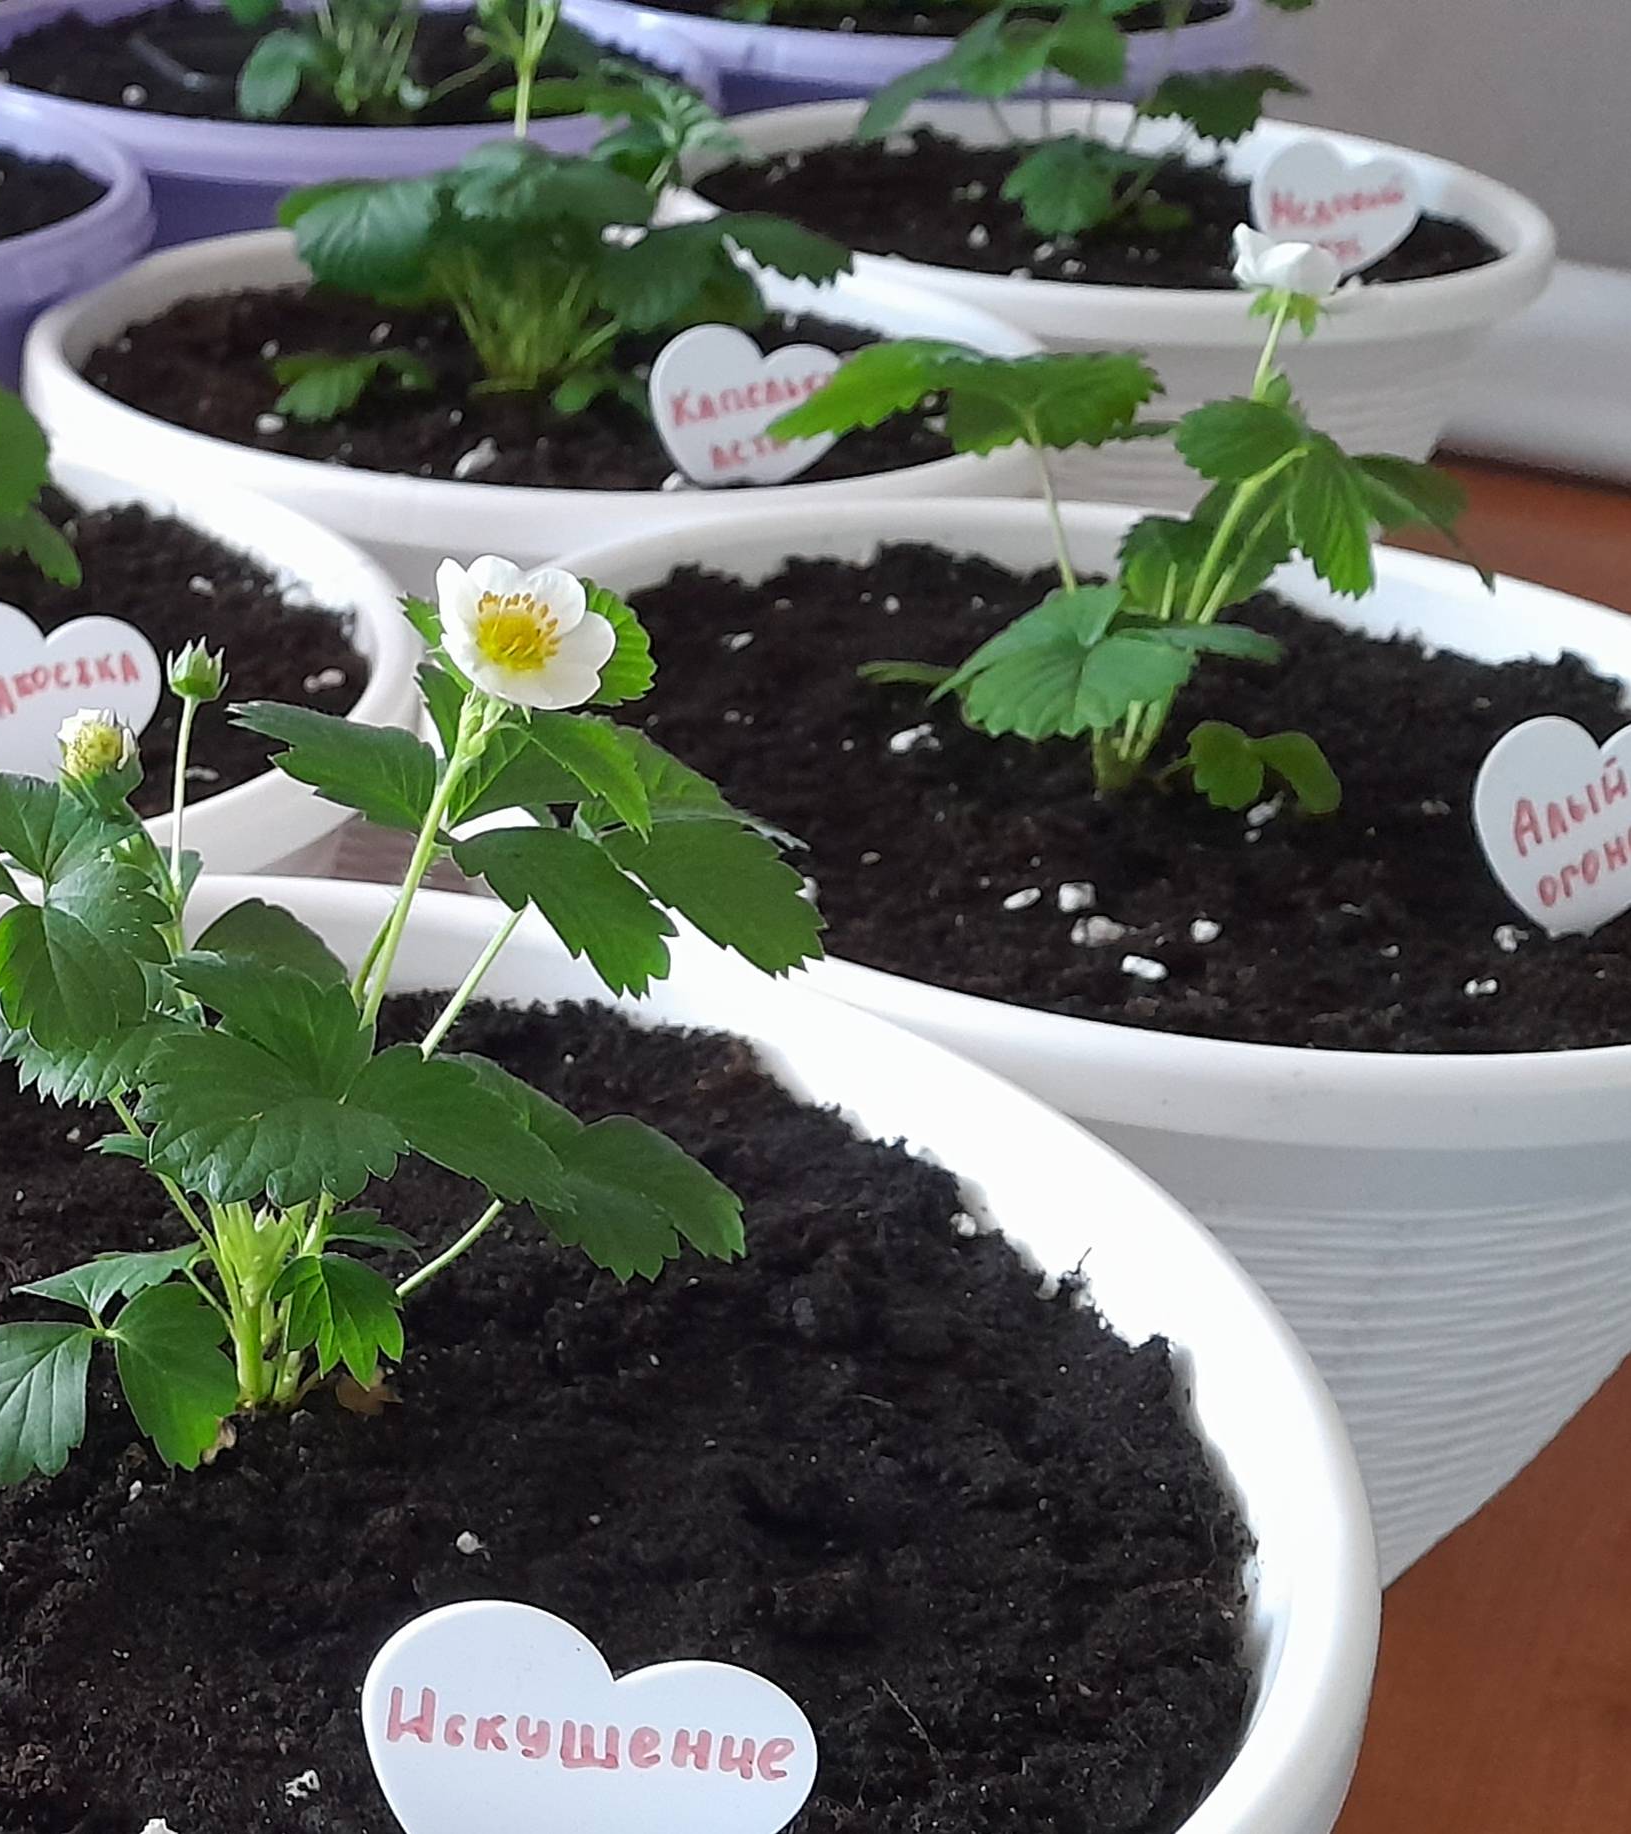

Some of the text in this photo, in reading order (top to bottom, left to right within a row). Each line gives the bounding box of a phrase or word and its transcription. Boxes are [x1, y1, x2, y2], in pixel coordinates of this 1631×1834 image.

[672, 372, 831, 426] Капельк
[1514, 756, 1628, 857] Алый
[1538, 826, 1631, 907] огон
[386, 1686, 796, 1781] Искушение
